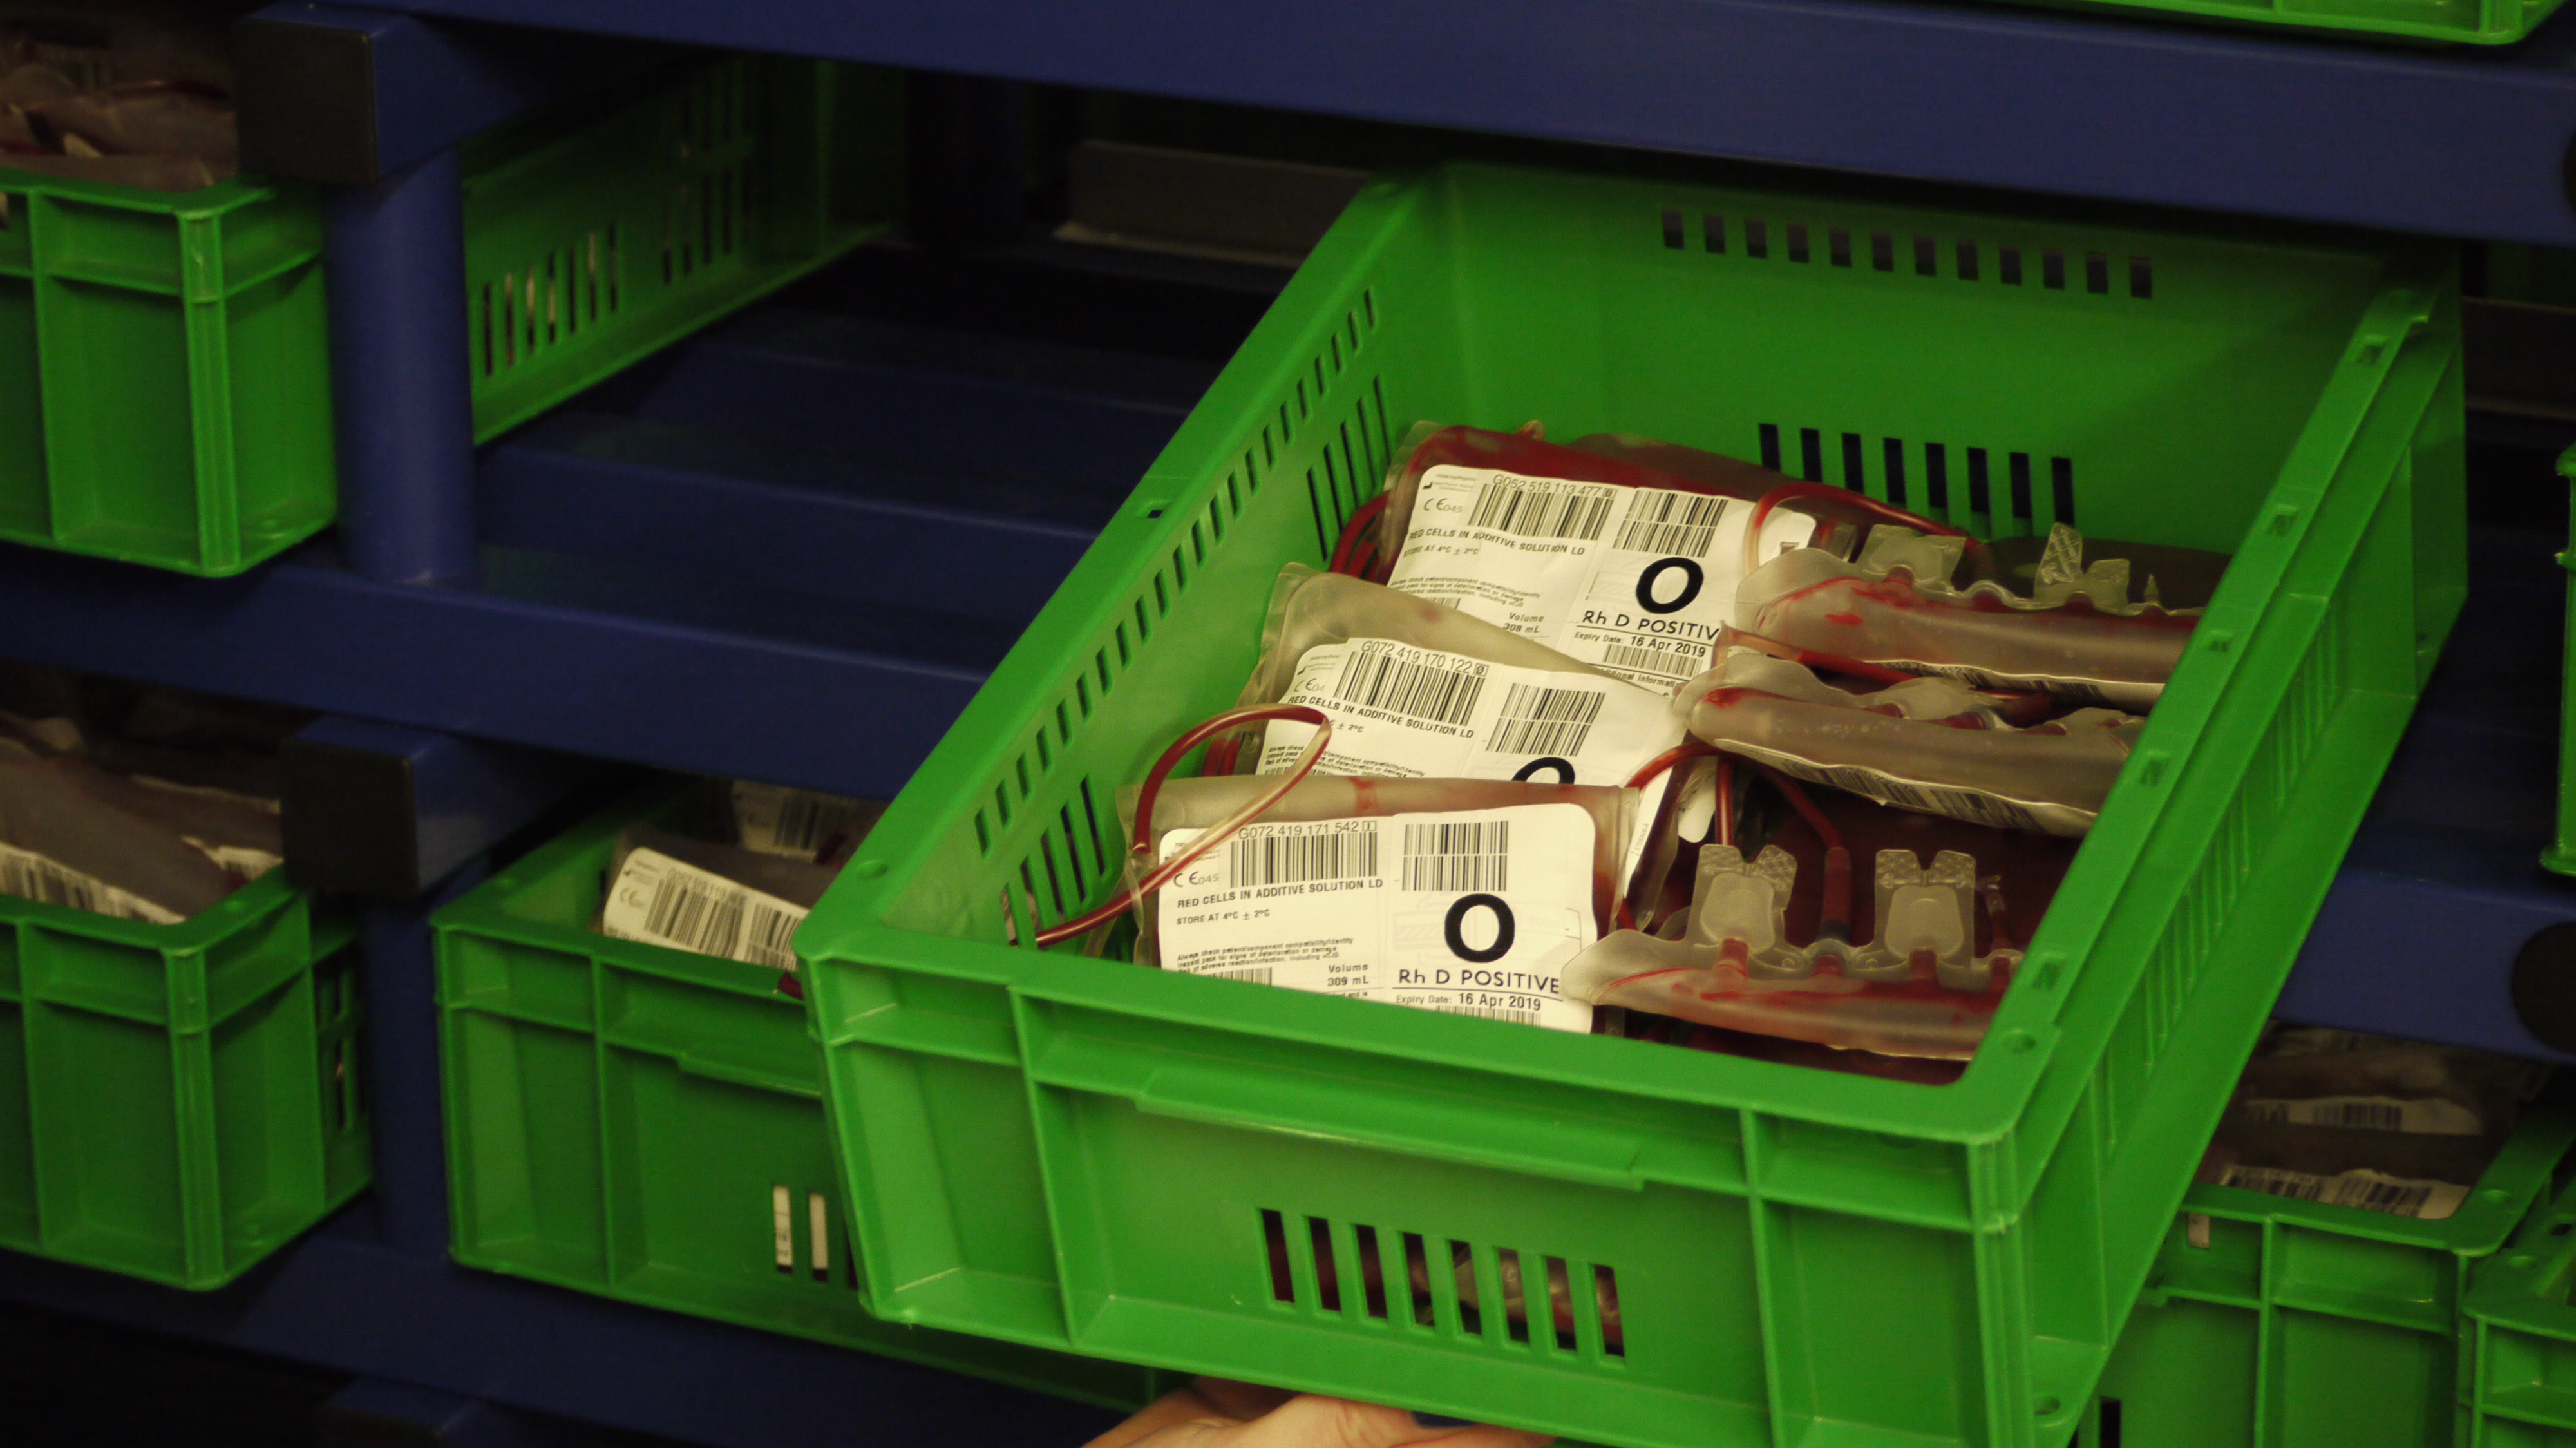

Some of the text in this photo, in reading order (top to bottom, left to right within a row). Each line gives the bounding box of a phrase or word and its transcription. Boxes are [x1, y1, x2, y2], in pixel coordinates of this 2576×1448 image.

[1493, 474, 1526, 491] G052
[1528, 481, 1551, 493] 519
[1554, 482, 1576, 495] 113
[1578, 486, 1602, 496] 477
[1408, 528, 1585, 555] RED CELLS IN ADDITIVE SOLUTION LD
[1635, 557, 1704, 614] O
[1502, 622, 1540, 633] 308 mL
[1508, 612, 1544, 622] Volume
[1582, 610, 1720, 640] Rh D POSITIV
[1361, 640, 1395, 656] G072
[1397, 647, 1420, 663] 419
[1424, 652, 1446, 669] 170
[1449, 657, 1473, 674] 122
[1574, 631, 1600, 642] Expiry
[1631, 635, 1645, 647] 16
[1648, 638, 1671, 652] Apr
[1674, 642, 1707, 658] 2019
[1288, 696, 1475, 739] RED CELLS IN ADDITIVE SOLUTION LD
[1238, 826, 1273, 840] G072
[1278, 824, 1302, 836] 419
[1307, 823, 1329, 835] 171
[1334, 821, 1359, 833] 542
[1177, 879, 1383, 909] RED CELLS IN ADDITIVE SOLUTION LD
[1177, 914, 1205, 925] STORE
[1208, 912, 1219, 922] AT
[1444, 893, 1515, 963] O
[1327, 975, 1369, 987] 309 mL
[1328, 964, 1368, 973] Volume
[1398, 969, 1560, 995] Rh D POSITIVE
[1396, 993, 1541, 1011] Expiry Date: 16 Apr 2019
